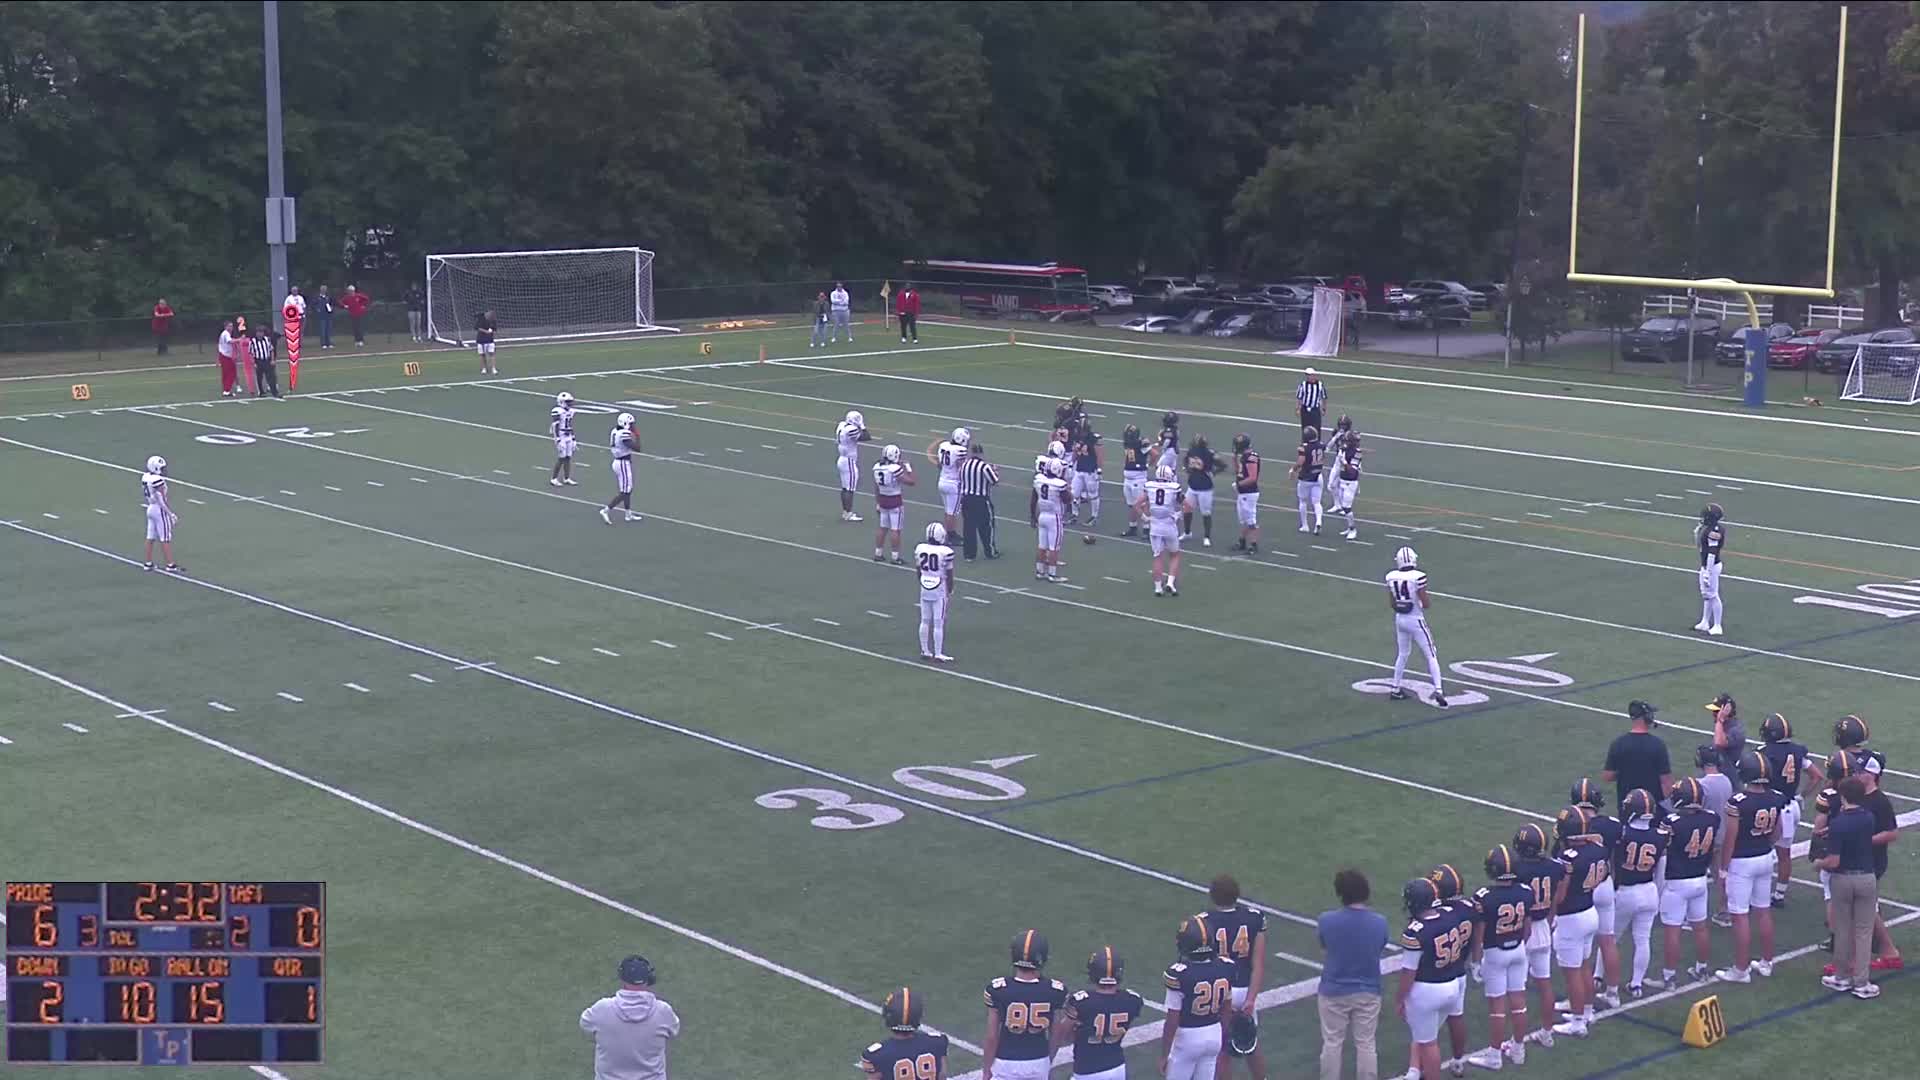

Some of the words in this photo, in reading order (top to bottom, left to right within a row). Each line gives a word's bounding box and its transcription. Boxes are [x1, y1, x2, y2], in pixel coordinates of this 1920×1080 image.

[406, 362, 418, 375] 10
[74, 386, 87, 398] 20
[878, 471, 886, 487] 3
[1040, 484, 1049, 500] 9
[1155, 488, 1166, 506] 8
[920, 552, 939, 571] 20
[1394, 580, 1411, 600] 14
[1781, 753, 1796, 784] 4
[754, 764, 1027, 830] 30
[1750, 806, 1777, 836] 91
[1621, 841, 1657, 872] 16
[1684, 826, 1714, 858] 44
[1530, 876, 1551, 910] 11
[1496, 901, 1525, 934] 21
[1215, 925, 1250, 958] 14
[1191, 978, 1232, 1016] 20
[1088, 1013, 1129, 1044] 15
[1699, 999, 1723, 1042] 30
